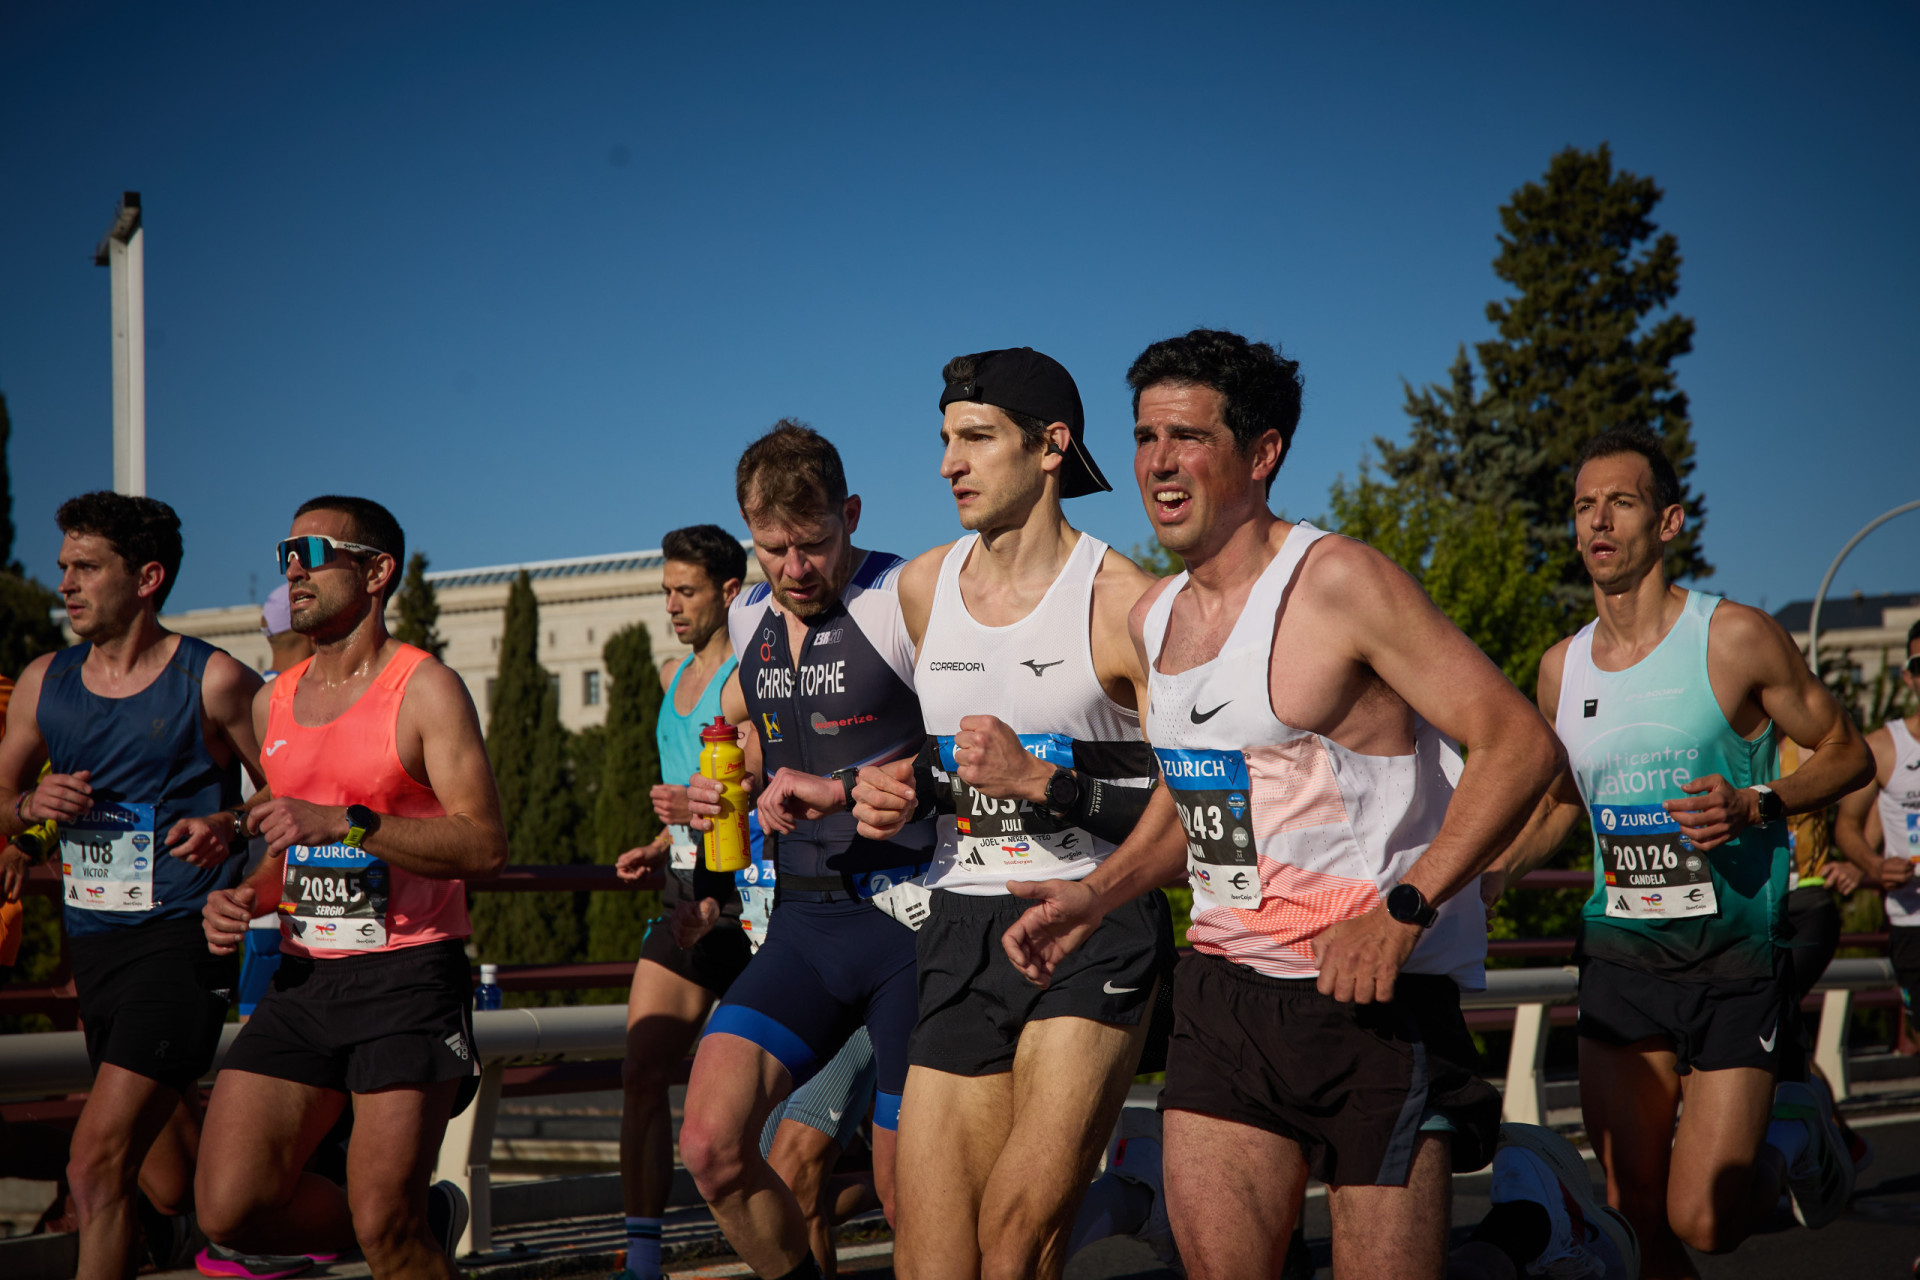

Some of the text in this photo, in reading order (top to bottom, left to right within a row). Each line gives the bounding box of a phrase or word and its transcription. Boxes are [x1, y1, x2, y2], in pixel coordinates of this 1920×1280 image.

[1164, 760, 1226, 777] ZURICH
[82, 809, 135, 823] ZURICH
[1620, 812, 1675, 827] ZURICH
[1000, 818, 1022, 832] JULI
[980, 838, 1000, 847] JOEL
[81, 841, 113, 864] 108
[313, 847, 366, 859] ZURICH
[1613, 844, 1678, 872] 20126
[83, 865, 109, 878] VÍCTOR
[1629, 874, 1666, 886] CANDELA
[300, 876, 361, 903] 20345
[315, 905, 345, 916] SERGIO
